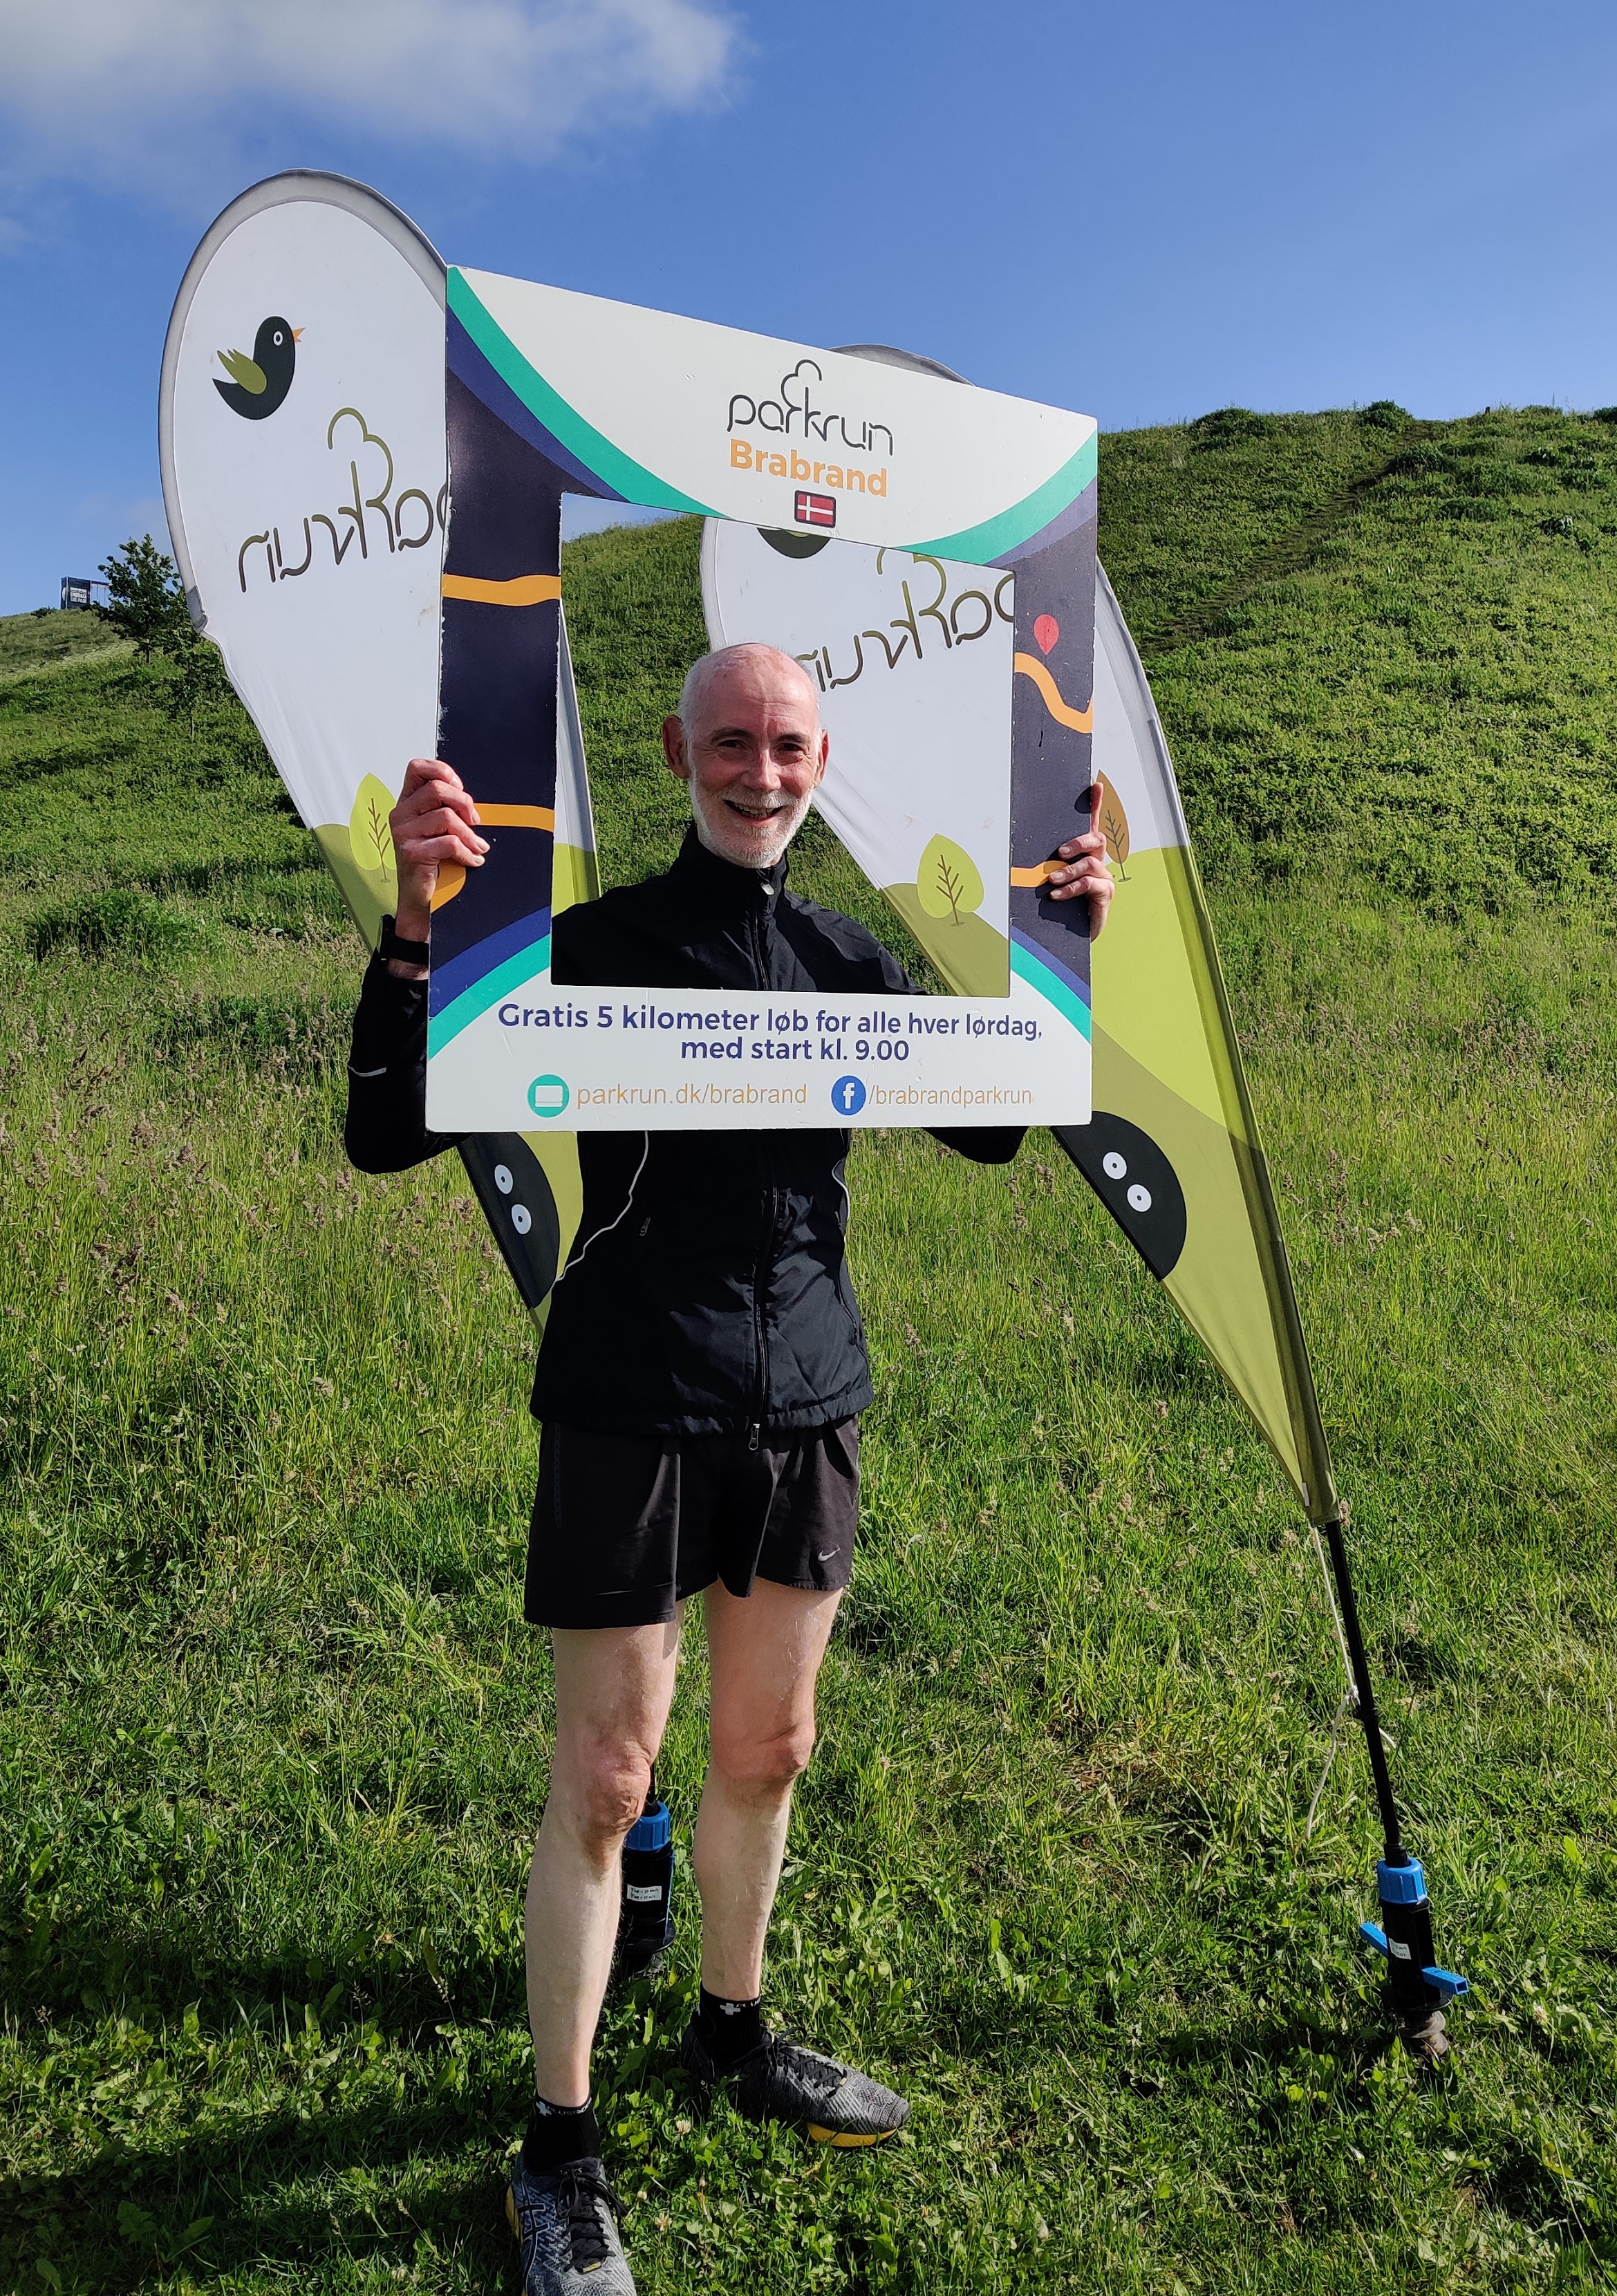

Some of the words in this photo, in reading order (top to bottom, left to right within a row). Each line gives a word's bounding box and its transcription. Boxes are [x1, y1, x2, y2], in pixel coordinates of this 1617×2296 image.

[727, 359, 893, 456] parkrun
[730, 439, 887, 497] Brabrand
[498, 1002, 588, 1028] Gratis
[597, 1005, 613, 1028] 5
[622, 1004, 760, 1031] kilometer
[767, 1008, 808, 1035] løb
[816, 1009, 851, 1032] for
[857, 1011, 901, 1034] alle
[908, 1012, 960, 1034] hver
[966, 1014, 1042, 1041] lørdag,
[681, 1036, 742, 1059] med
[751, 1039, 812, 1060] start
[821, 1038, 848, 1061] kl.
[855, 1039, 909, 1061] 9.00
[577, 1083, 807, 1110] parkrun.dk/brabrand
[868, 1084, 1032, 1109] /brabrandparkrun
